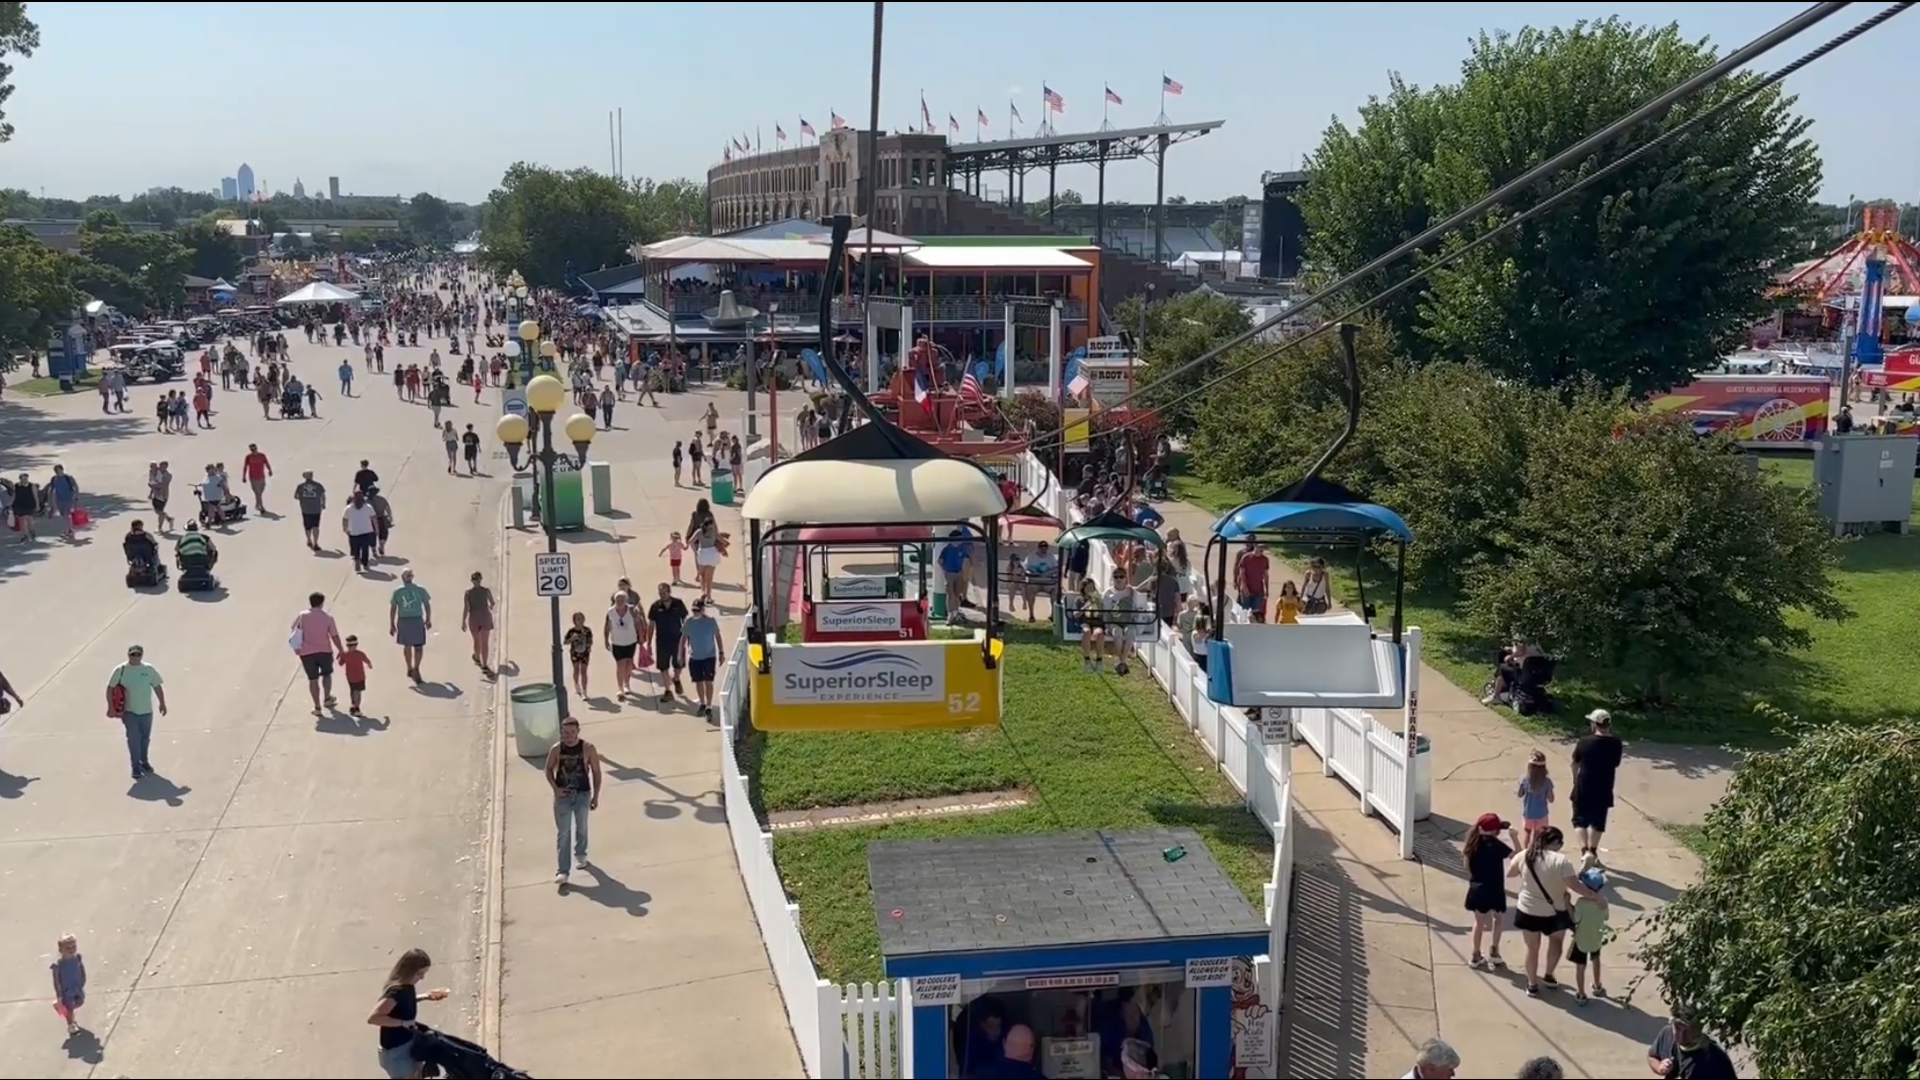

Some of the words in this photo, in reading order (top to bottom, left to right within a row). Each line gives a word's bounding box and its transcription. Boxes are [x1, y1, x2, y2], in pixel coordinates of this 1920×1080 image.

[1089, 341, 1113, 350] ROOT
[1098, 371, 1122, 380] ROOT
[539, 557, 567, 566] SPEED
[542, 566, 564, 574] LIMIT
[540, 575, 568, 591] 20
[833, 585, 883, 593] SuperiorSleep
[822, 616, 896, 627] SuperiorSleep
[900, 629, 913, 639] 51
[785, 671, 933, 694] SuperiorSleep
[819, 692, 900, 701] EXPERIENCE
[948, 692, 980, 714] 52
[1409, 690, 1417, 758] ENTRANCE
[928, 976, 956, 984] COOLERS
[947, 983, 959, 991] ON
[1247, 1019, 1265, 1028] Hey
[1243, 1028, 1263, 1036] Kids
